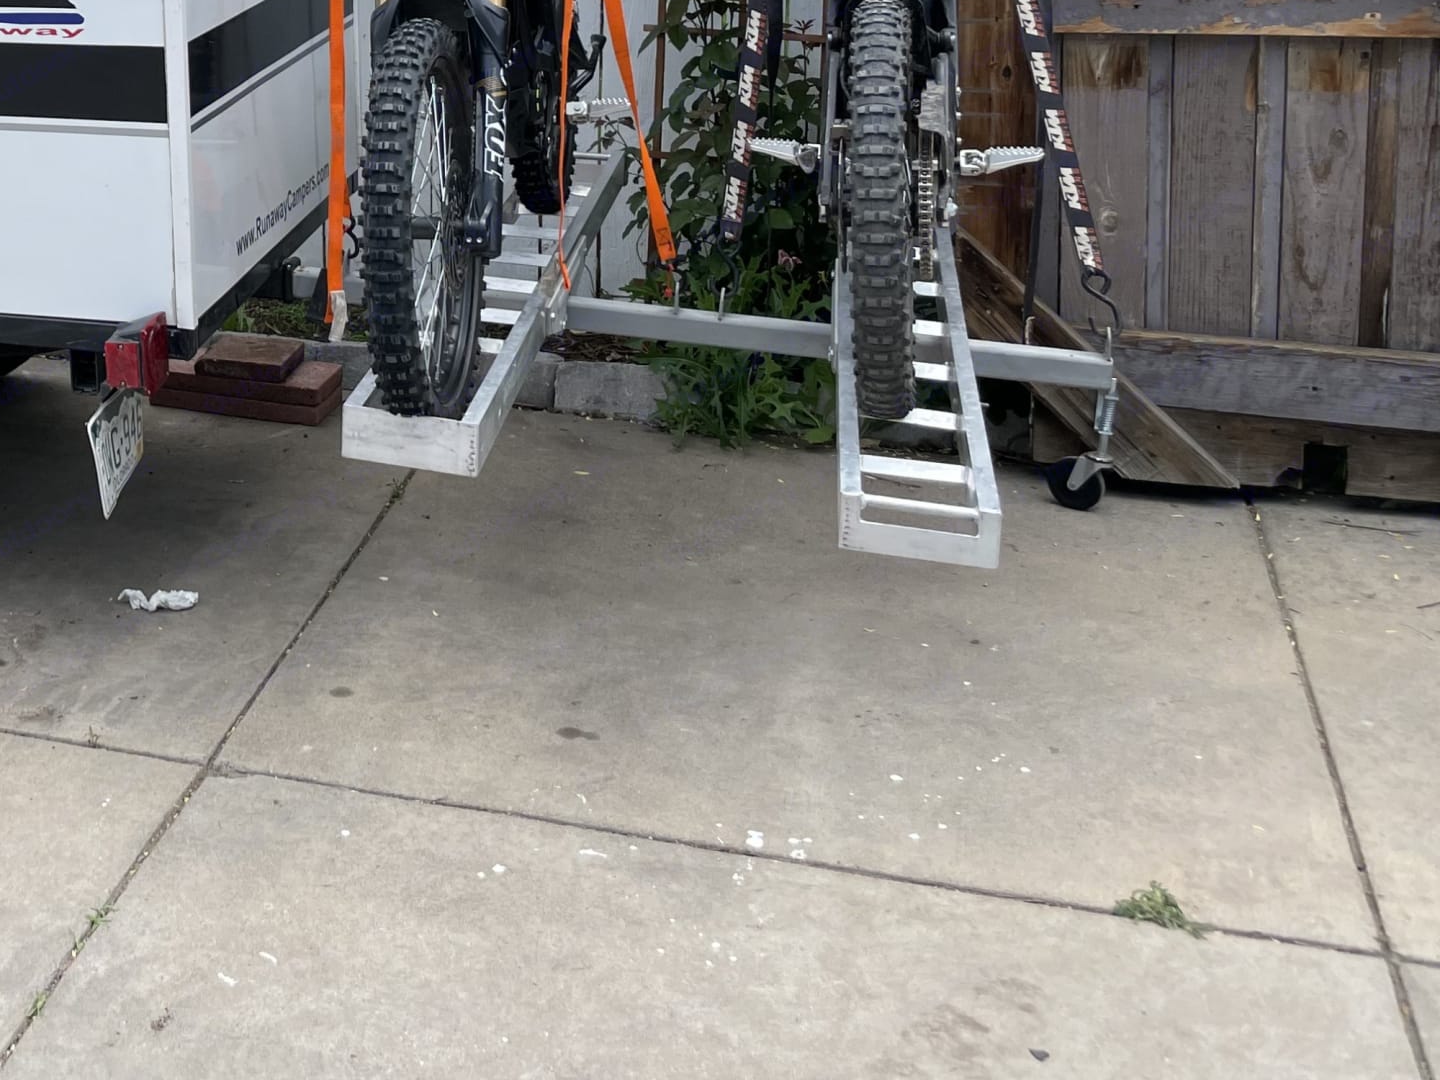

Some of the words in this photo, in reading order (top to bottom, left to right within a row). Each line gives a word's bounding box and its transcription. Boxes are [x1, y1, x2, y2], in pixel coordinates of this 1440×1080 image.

[745, 10, 761, 52] KTM
[738, 64, 755, 108] KTM
[1031, 51, 1053, 94] KTM
[483, 92, 507, 182] FOX
[731, 120, 748, 164] KTM
[1044, 109, 1067, 151] KTM
[235, 163, 330, 256] www.RunawayCampers.com
[723, 177, 741, 220] KTM
[1059, 167, 1081, 210] KTM
[1074, 227, 1096, 267] KTM
